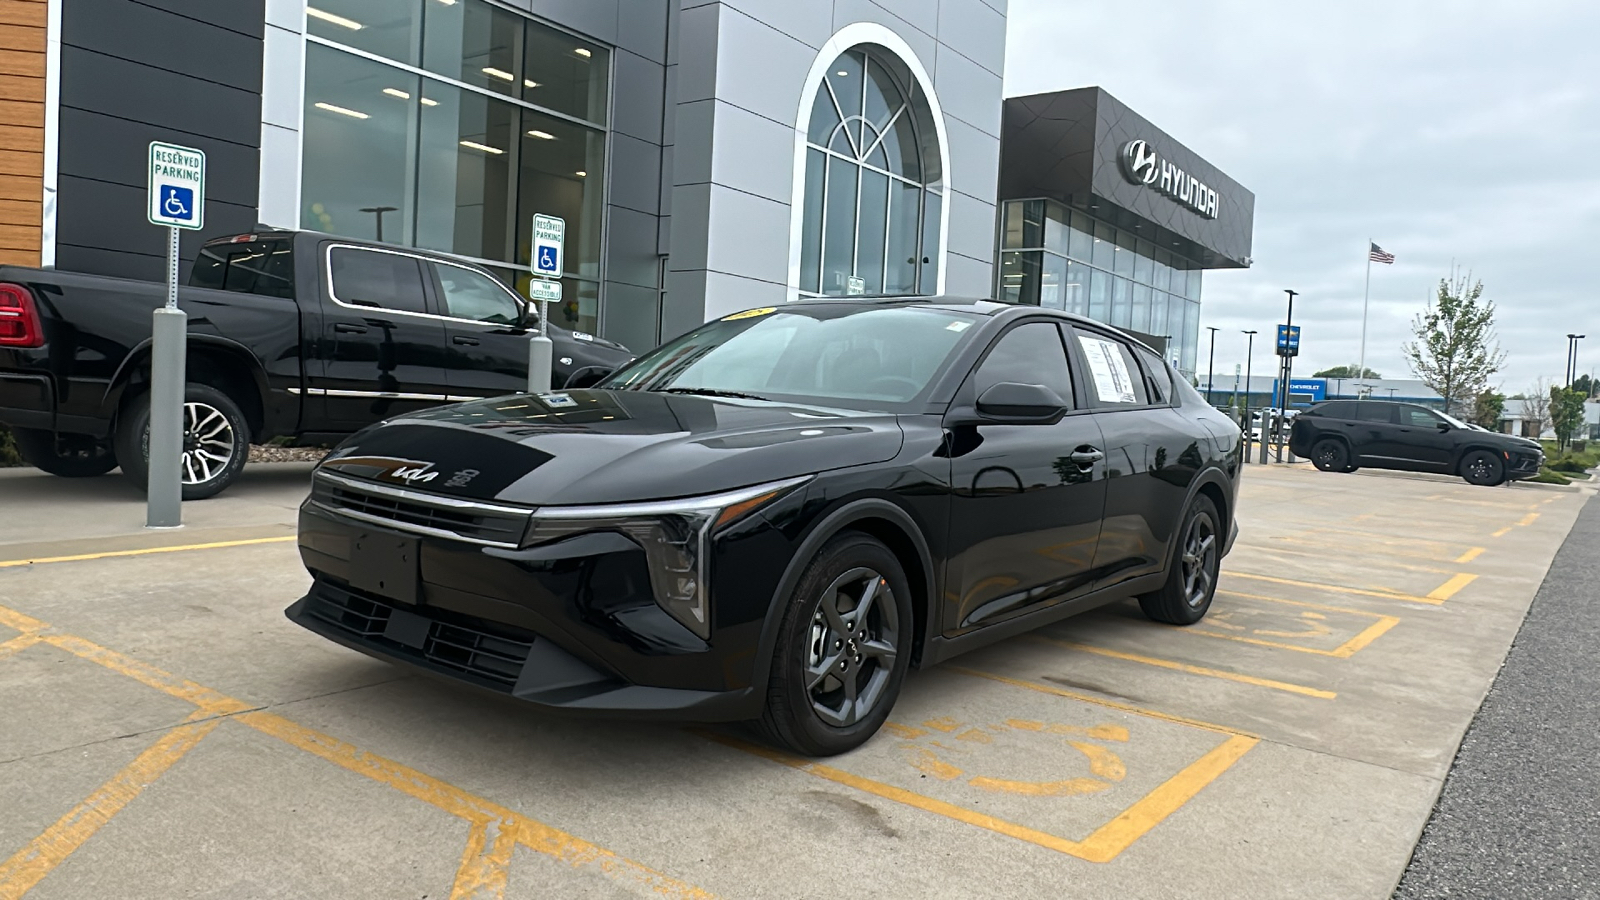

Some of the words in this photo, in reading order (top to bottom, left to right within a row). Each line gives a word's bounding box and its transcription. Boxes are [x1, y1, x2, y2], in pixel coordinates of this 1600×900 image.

[156, 150, 200, 168] RESERVED
[155, 164, 199, 182] PARKING
[1160, 159, 1219, 219] HYUNDAI
[536, 220, 561, 232] RESERVED
[536, 230, 561, 243] PARKING
